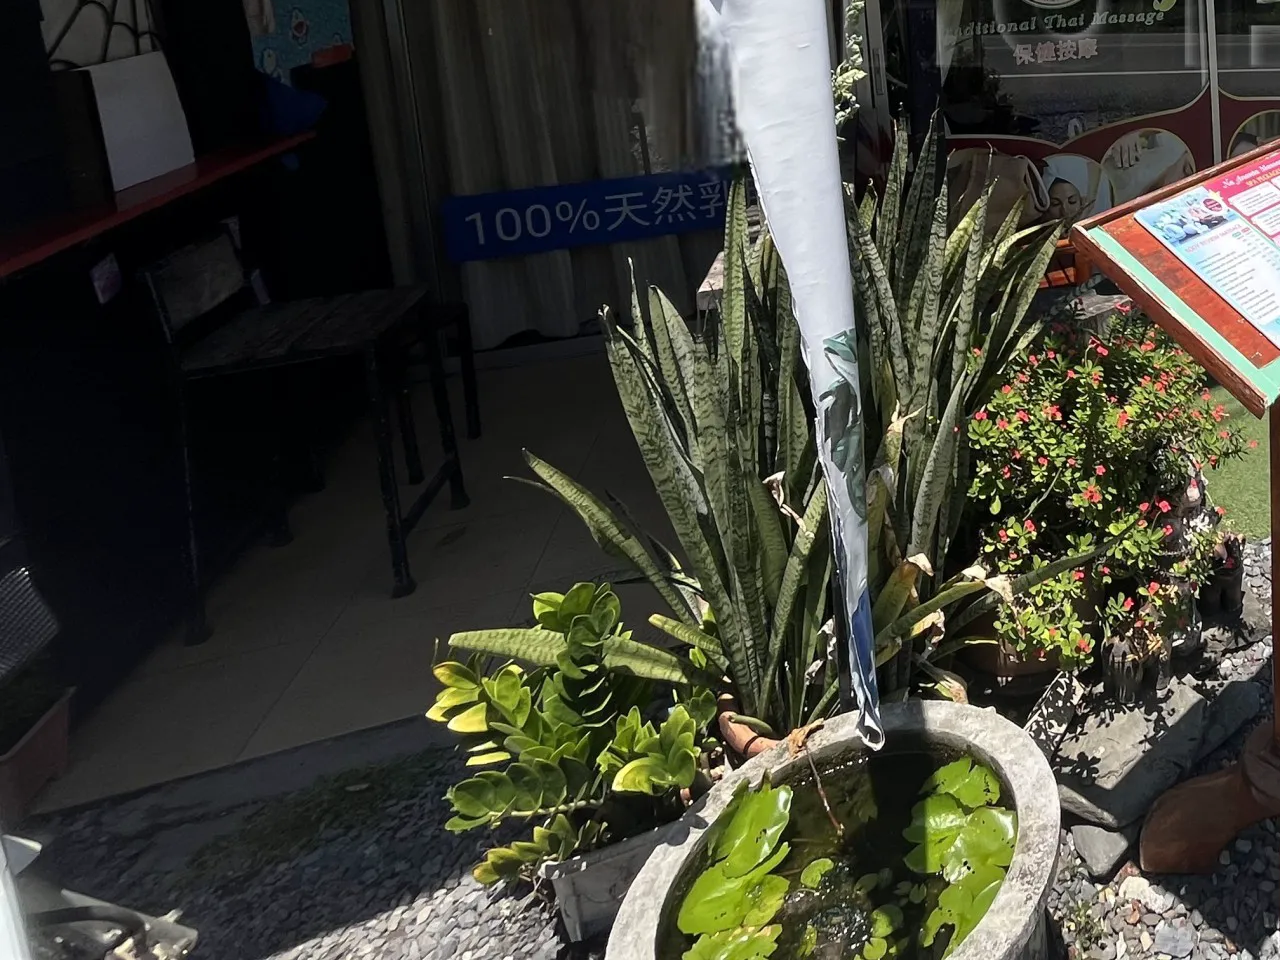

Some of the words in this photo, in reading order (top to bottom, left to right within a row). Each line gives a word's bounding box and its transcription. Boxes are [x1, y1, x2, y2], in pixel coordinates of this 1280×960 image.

[1043, 13, 1085, 30] Thai
[1092, 10, 1165, 26] Massage
[1013, 38, 1099, 66] 保健按摩
